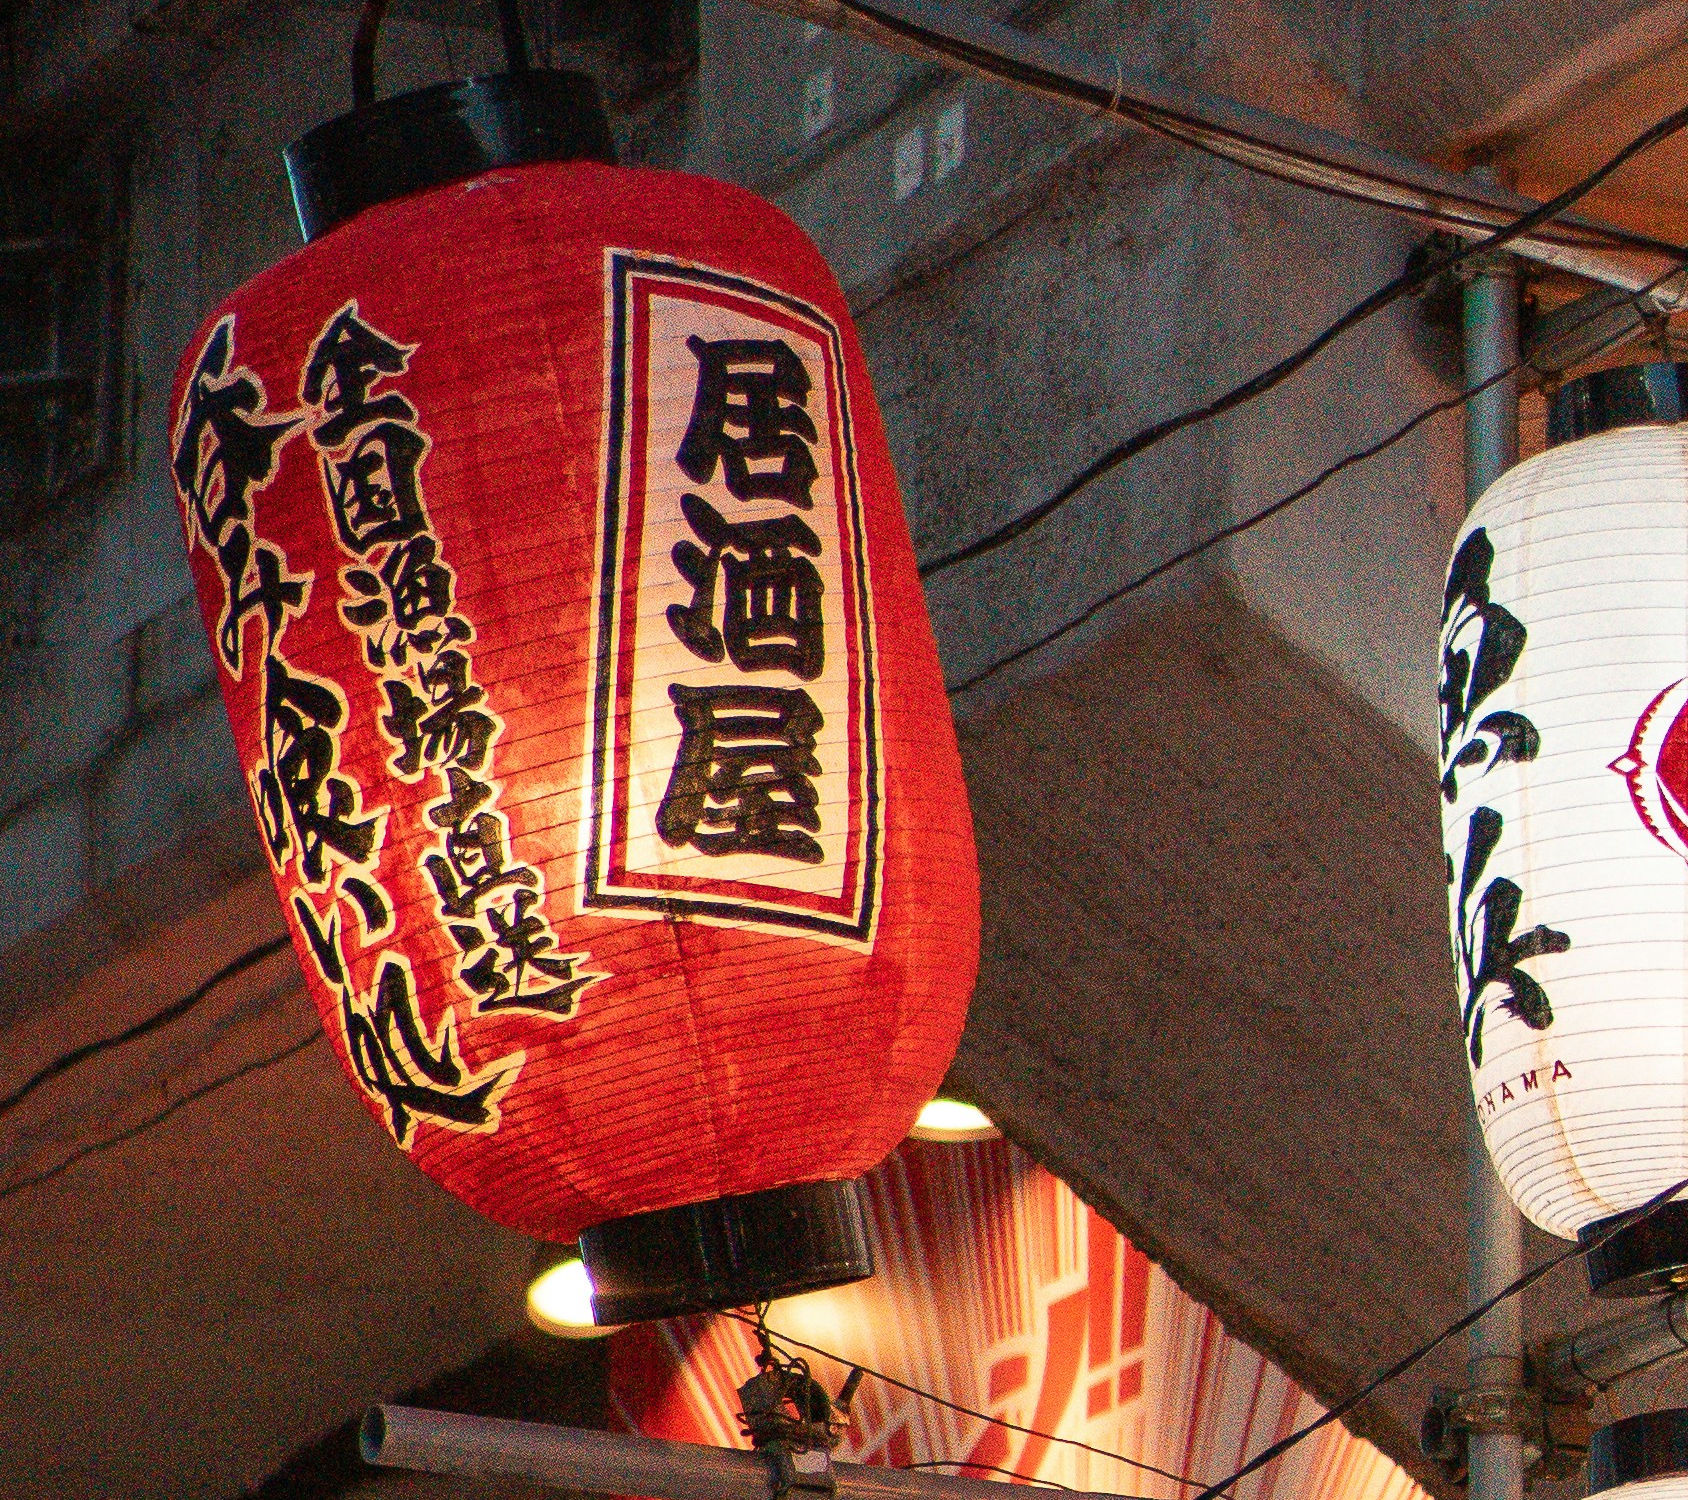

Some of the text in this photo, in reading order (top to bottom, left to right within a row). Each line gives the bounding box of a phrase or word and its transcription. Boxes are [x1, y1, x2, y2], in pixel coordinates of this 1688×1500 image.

[300, 302, 600, 1020] 全国漁場直送
[654, 334, 828, 864] 居酒屋
